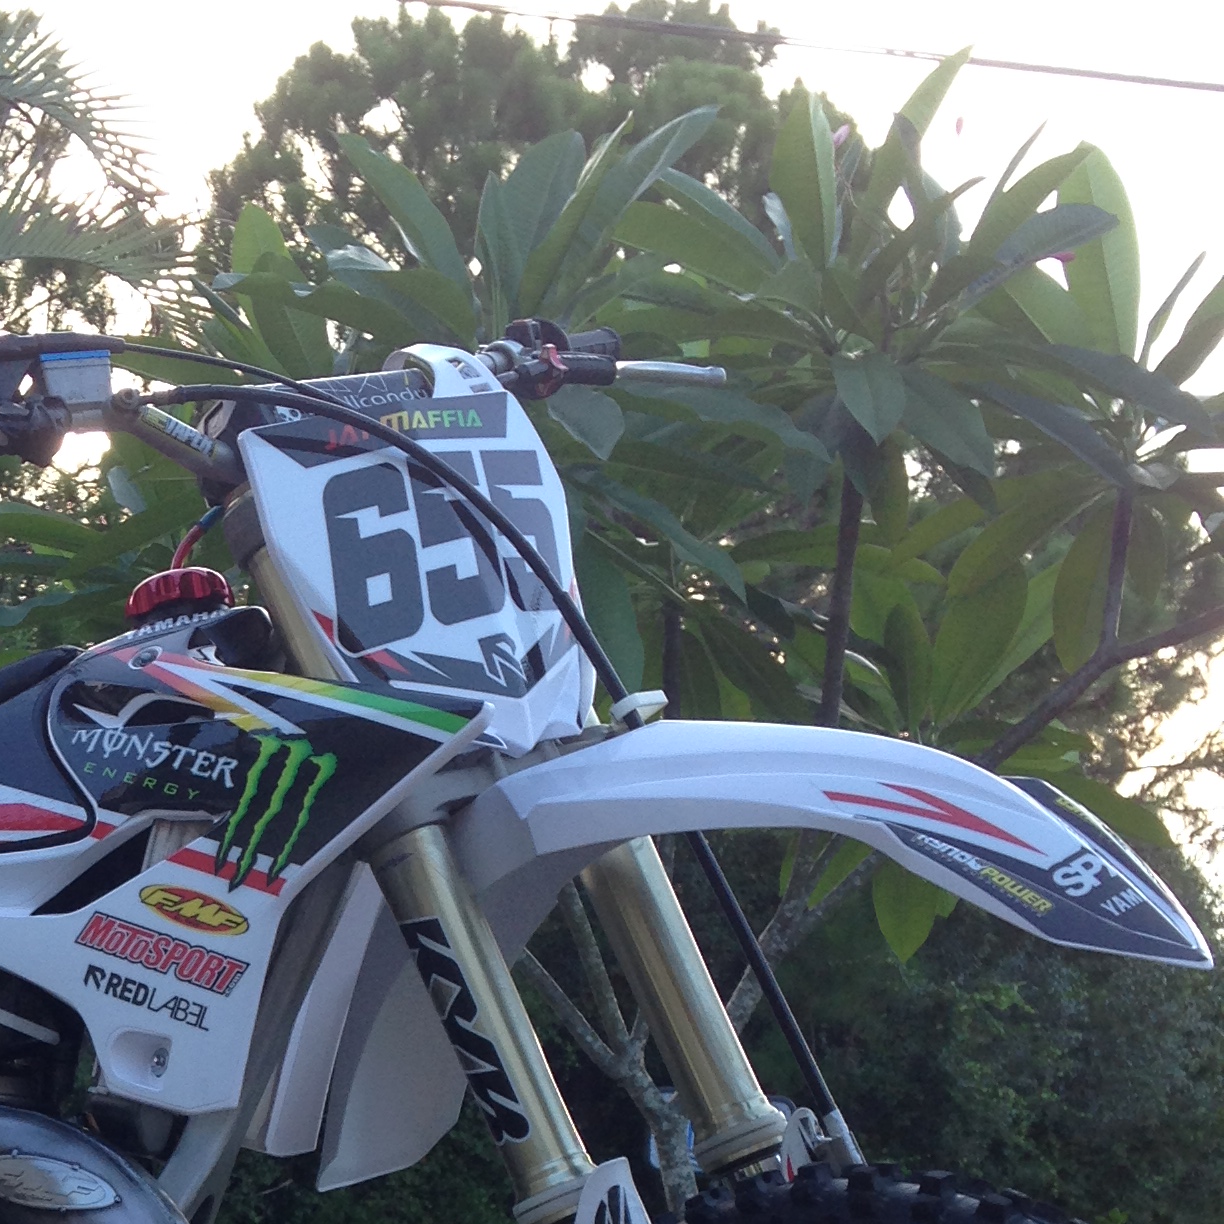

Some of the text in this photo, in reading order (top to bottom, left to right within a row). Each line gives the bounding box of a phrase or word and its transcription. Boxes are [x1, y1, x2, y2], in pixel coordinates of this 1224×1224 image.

[325, 409, 484, 450] JA MAFFIA
[322, 449, 564, 656] 655
[72, 726, 239, 789] MONSTER
[83, 761, 200, 800] ENERGY
[141, 888, 249, 929] FMF
[980, 866, 1055, 913] POWER
